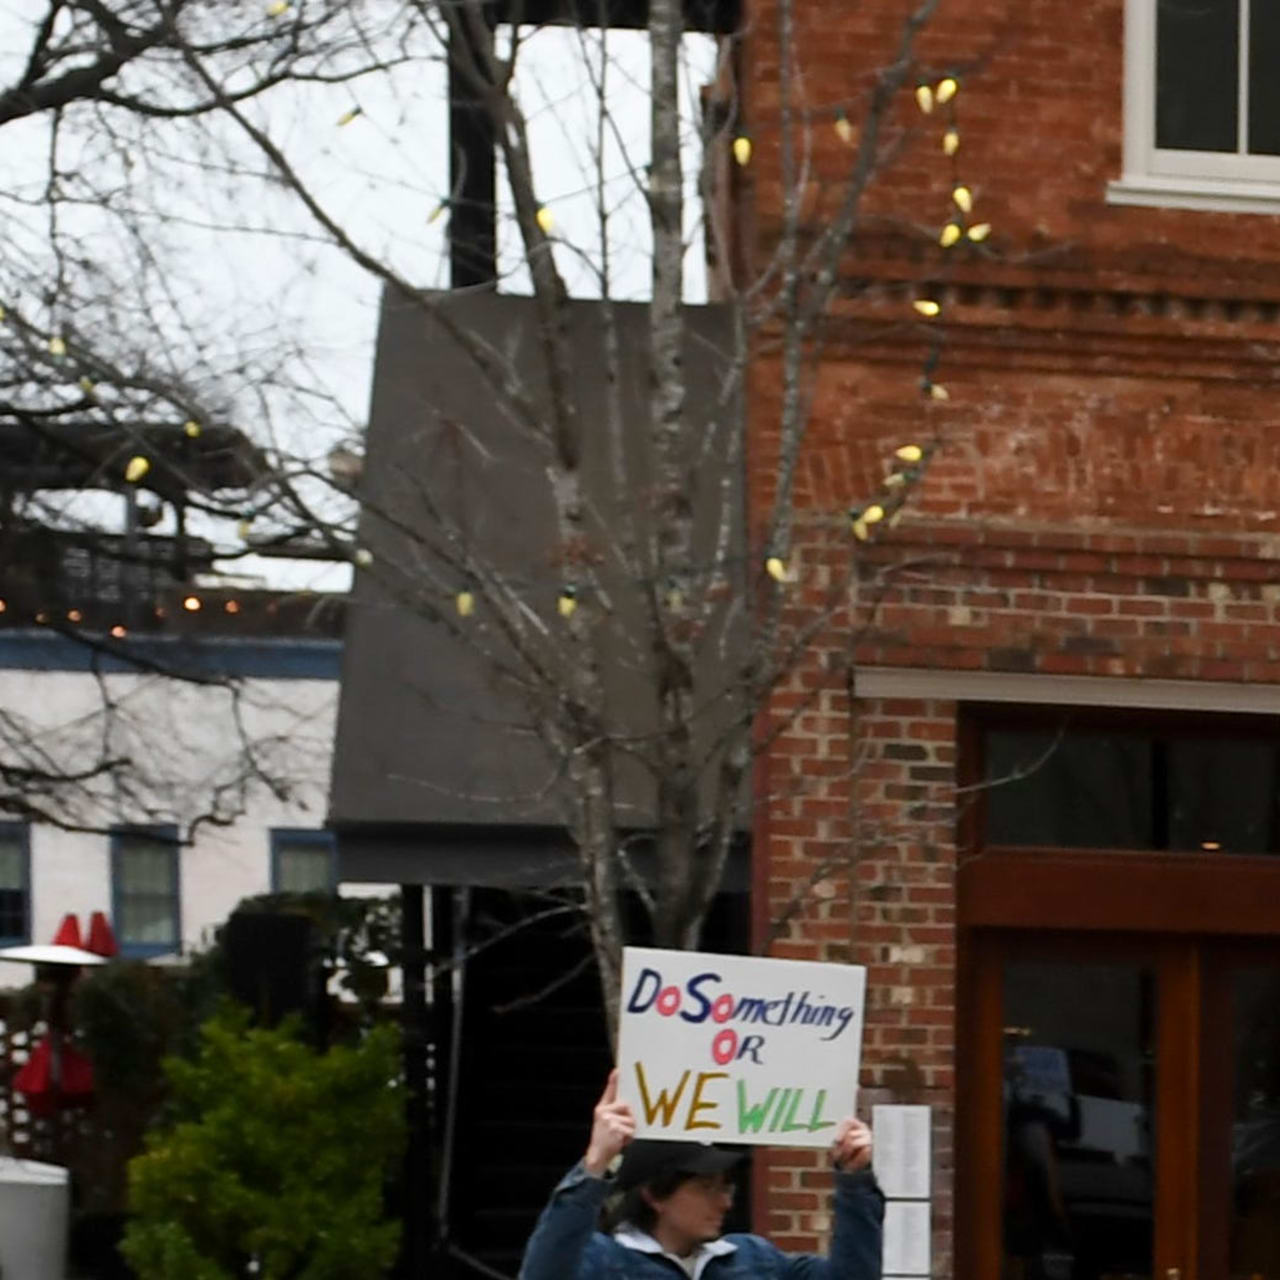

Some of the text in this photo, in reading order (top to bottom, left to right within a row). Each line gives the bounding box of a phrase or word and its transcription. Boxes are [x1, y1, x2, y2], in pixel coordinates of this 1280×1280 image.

[711, 1028, 765, 1066] OR
[634, 1061, 837, 1134] WE WILL
